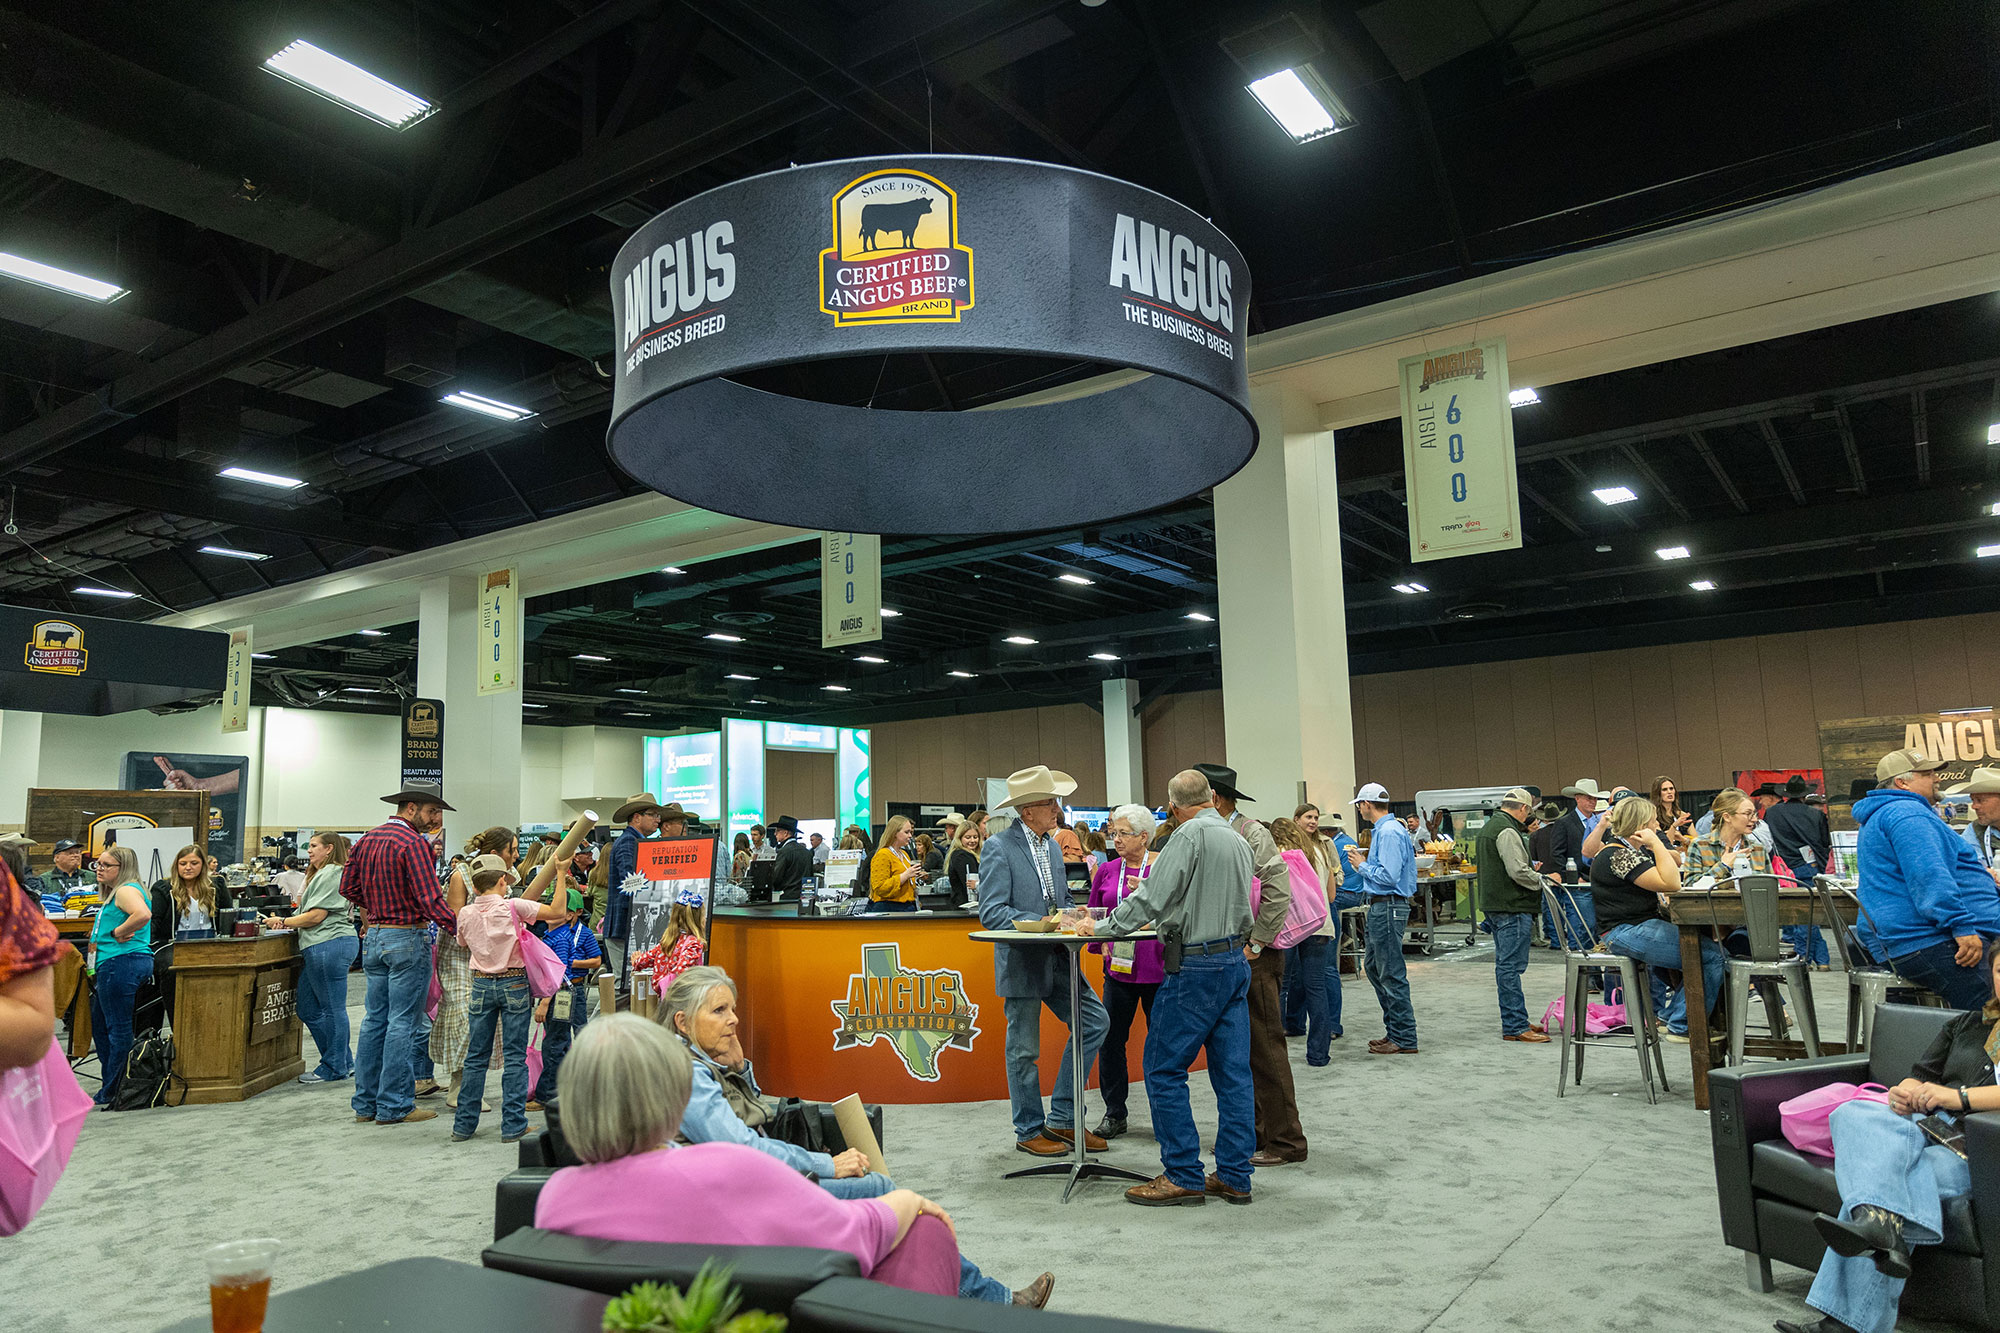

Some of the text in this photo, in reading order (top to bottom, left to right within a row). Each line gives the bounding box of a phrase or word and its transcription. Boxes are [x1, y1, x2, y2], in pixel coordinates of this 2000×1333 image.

[861, 182, 928, 198] SINCE 1978
[836, 254, 950, 286] CERTIFIED
[1109, 213, 1234, 333] ANGUS
[624, 220, 736, 352] ANGUS
[828, 282, 905, 307] ANGUS
[902, 300, 949, 314] BRAND
[1122, 302, 1234, 361] THE BUSINESS BREED
[626, 314, 726, 376] THE BUSINESS BREED
[1418, 401, 1437, 449] AISLE
[840, 617, 863, 631] ANGUS
[28, 656, 60, 665] ANGUS
[32, 650, 79, 658] CERTIFIED
[407, 740, 439, 749] BRAND
[407, 750, 438, 759] STORE
[652, 845, 698, 855] REPUTATION
[652, 854, 698, 865] VERIFIED
[267, 982, 281, 993] THE
[847, 976, 955, 1017] ANGUS
[856, 1015, 956, 1032] CONVENTION
